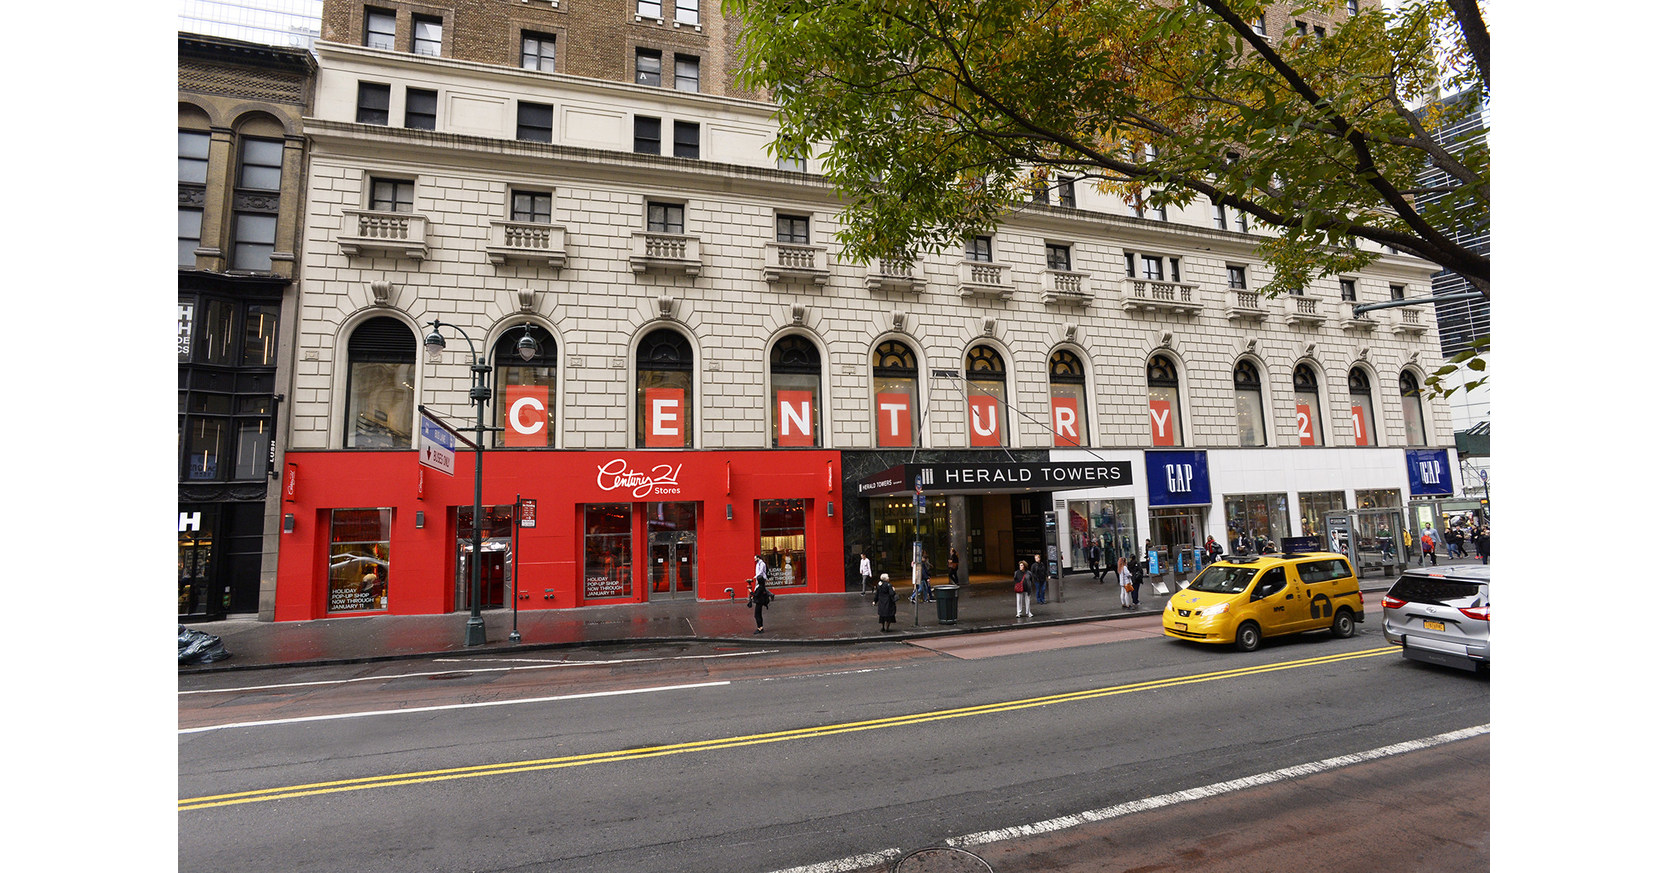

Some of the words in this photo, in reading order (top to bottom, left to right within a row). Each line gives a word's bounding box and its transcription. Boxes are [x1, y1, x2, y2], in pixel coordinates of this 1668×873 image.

[597, 458, 657, 498] Century
[651, 463, 683, 482] 21
[946, 469, 1032, 483] HERALD
[1041, 467, 1121, 481] TOWERS
[1165, 463, 1193, 493] GAP
[1420, 460, 1441, 484] GAP
[654, 487, 681, 495] Stores
[1273, 605, 1285, 613] NYC
